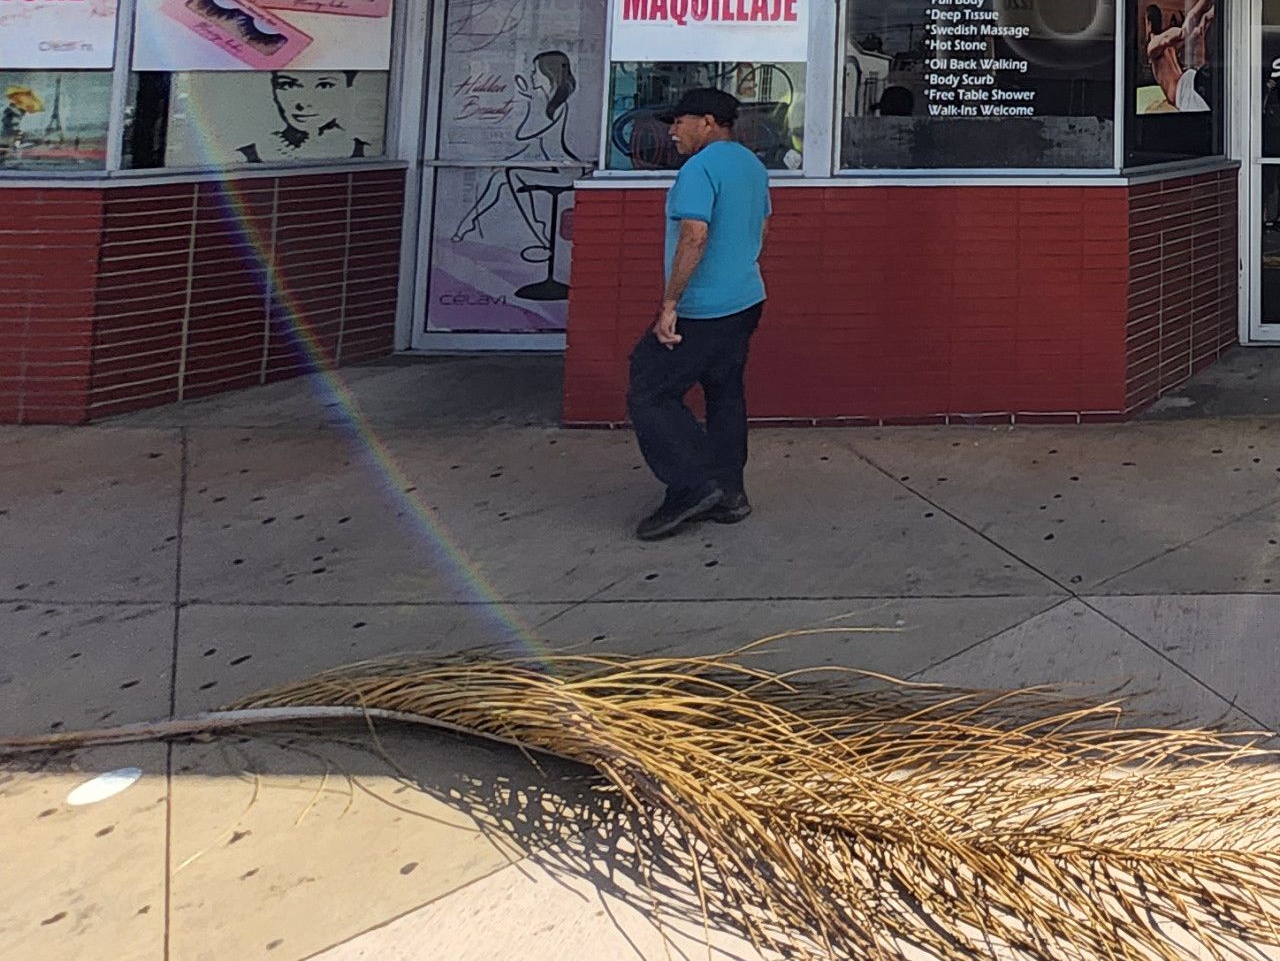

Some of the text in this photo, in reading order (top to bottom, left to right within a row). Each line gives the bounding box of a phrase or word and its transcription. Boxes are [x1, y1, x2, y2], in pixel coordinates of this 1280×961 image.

[964, 9, 999, 20] Tissue
[980, 25, 1030, 38] Massage
[954, 40, 987, 50] Stone
[949, 59, 977, 69] Back
[980, 58, 1028, 72] Walking
[962, 74, 994, 85] Scurb
[957, 89, 989, 100] Table
[991, 89, 1035, 100] Shower
[928, 104, 1034, 115] Walk-Ins Welcome
